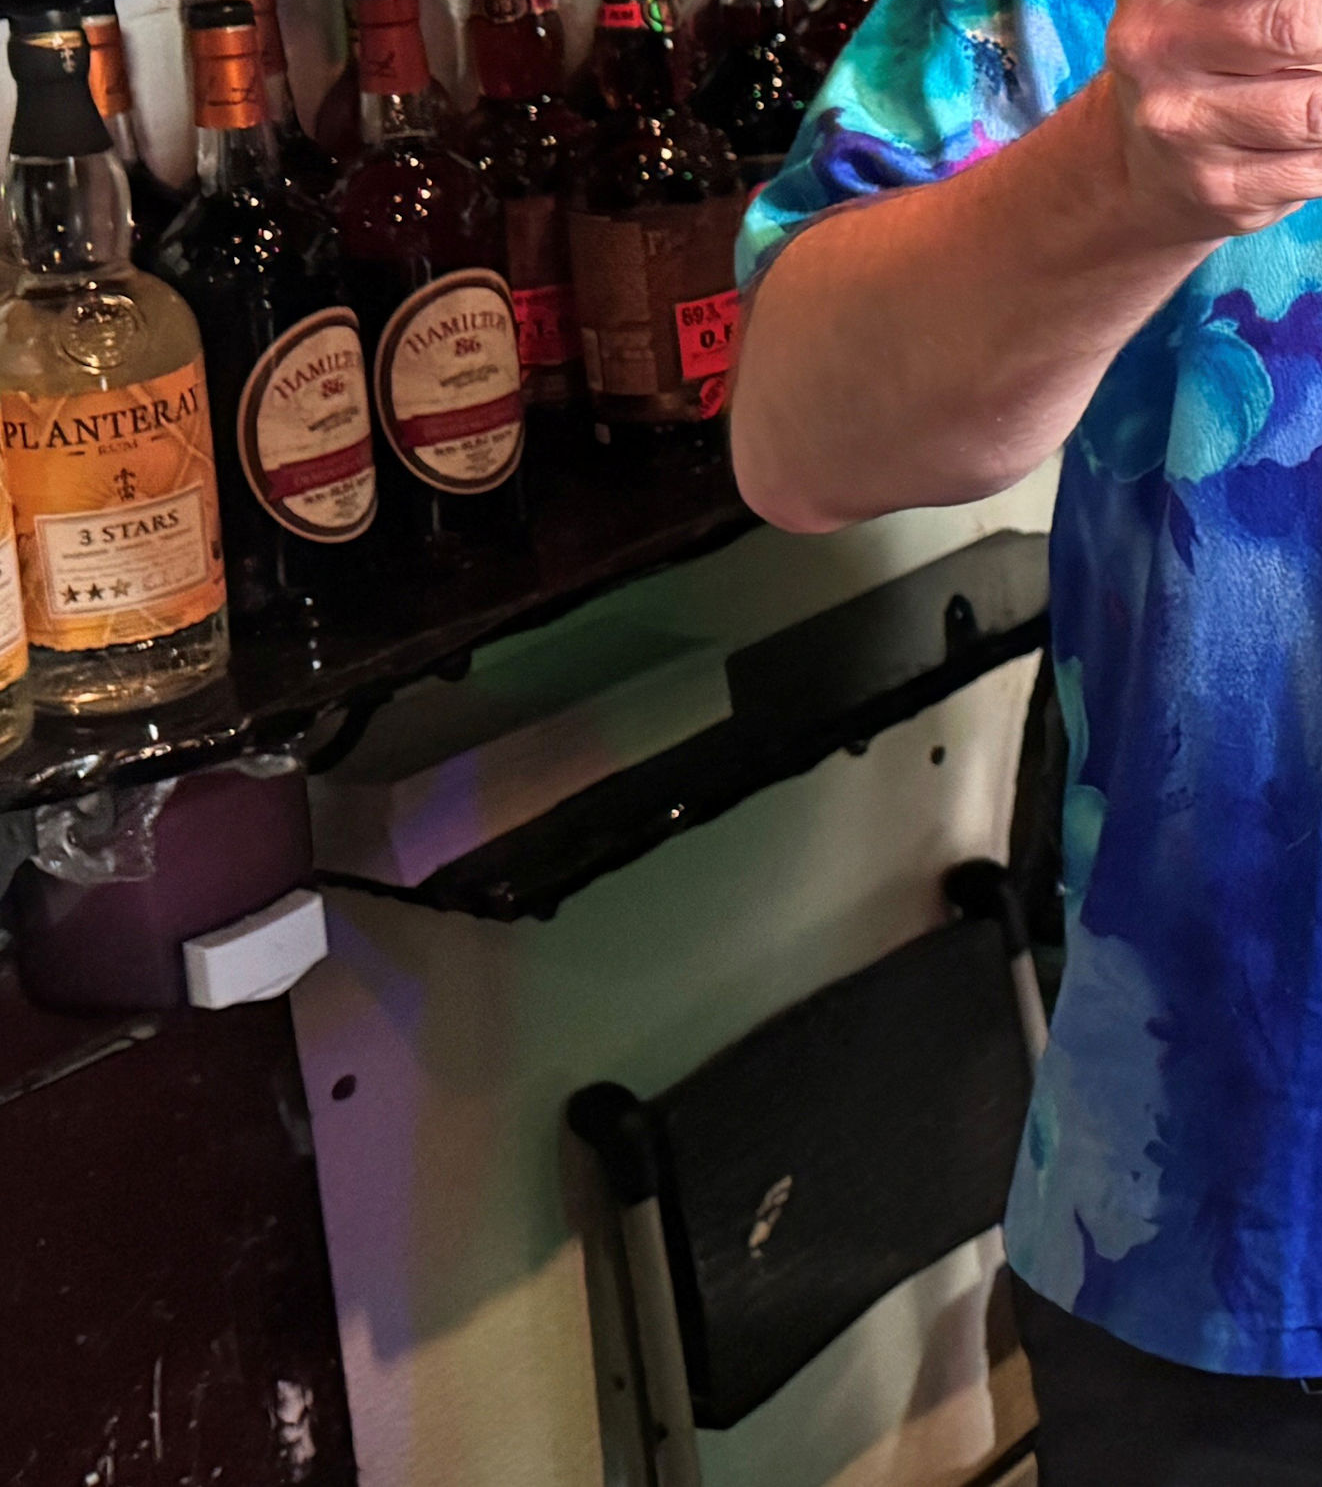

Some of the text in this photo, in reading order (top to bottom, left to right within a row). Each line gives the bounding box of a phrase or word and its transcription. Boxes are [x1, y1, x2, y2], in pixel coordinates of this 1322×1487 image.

[455, 335, 482, 358] 86
[320, 376, 345, 399] 86
[97, 439, 139, 456] RUM
[79, 510, 180, 547] 3 STARS
